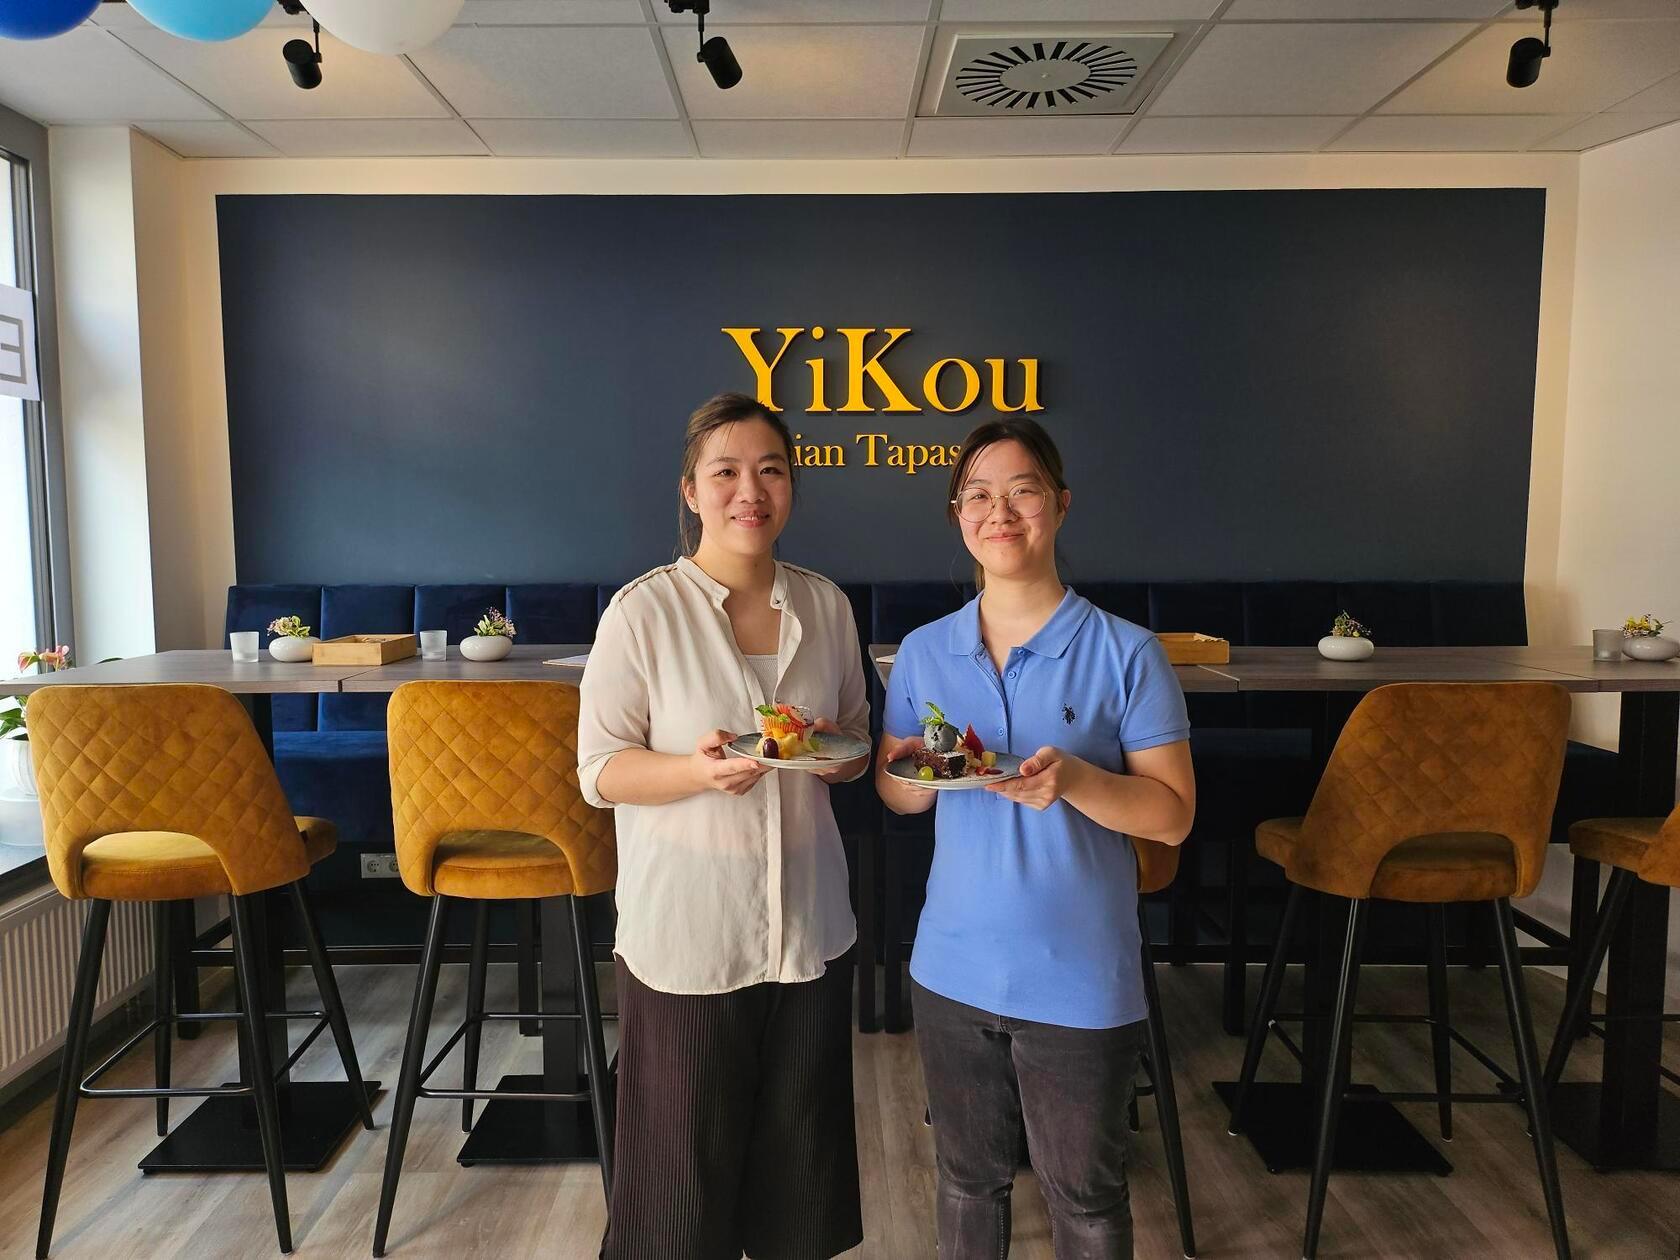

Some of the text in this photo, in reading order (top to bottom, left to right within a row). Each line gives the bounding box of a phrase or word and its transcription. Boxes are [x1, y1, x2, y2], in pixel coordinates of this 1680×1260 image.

[720, 326, 1046, 413] YiKou
[793, 433, 961, 475] ian Tapas
